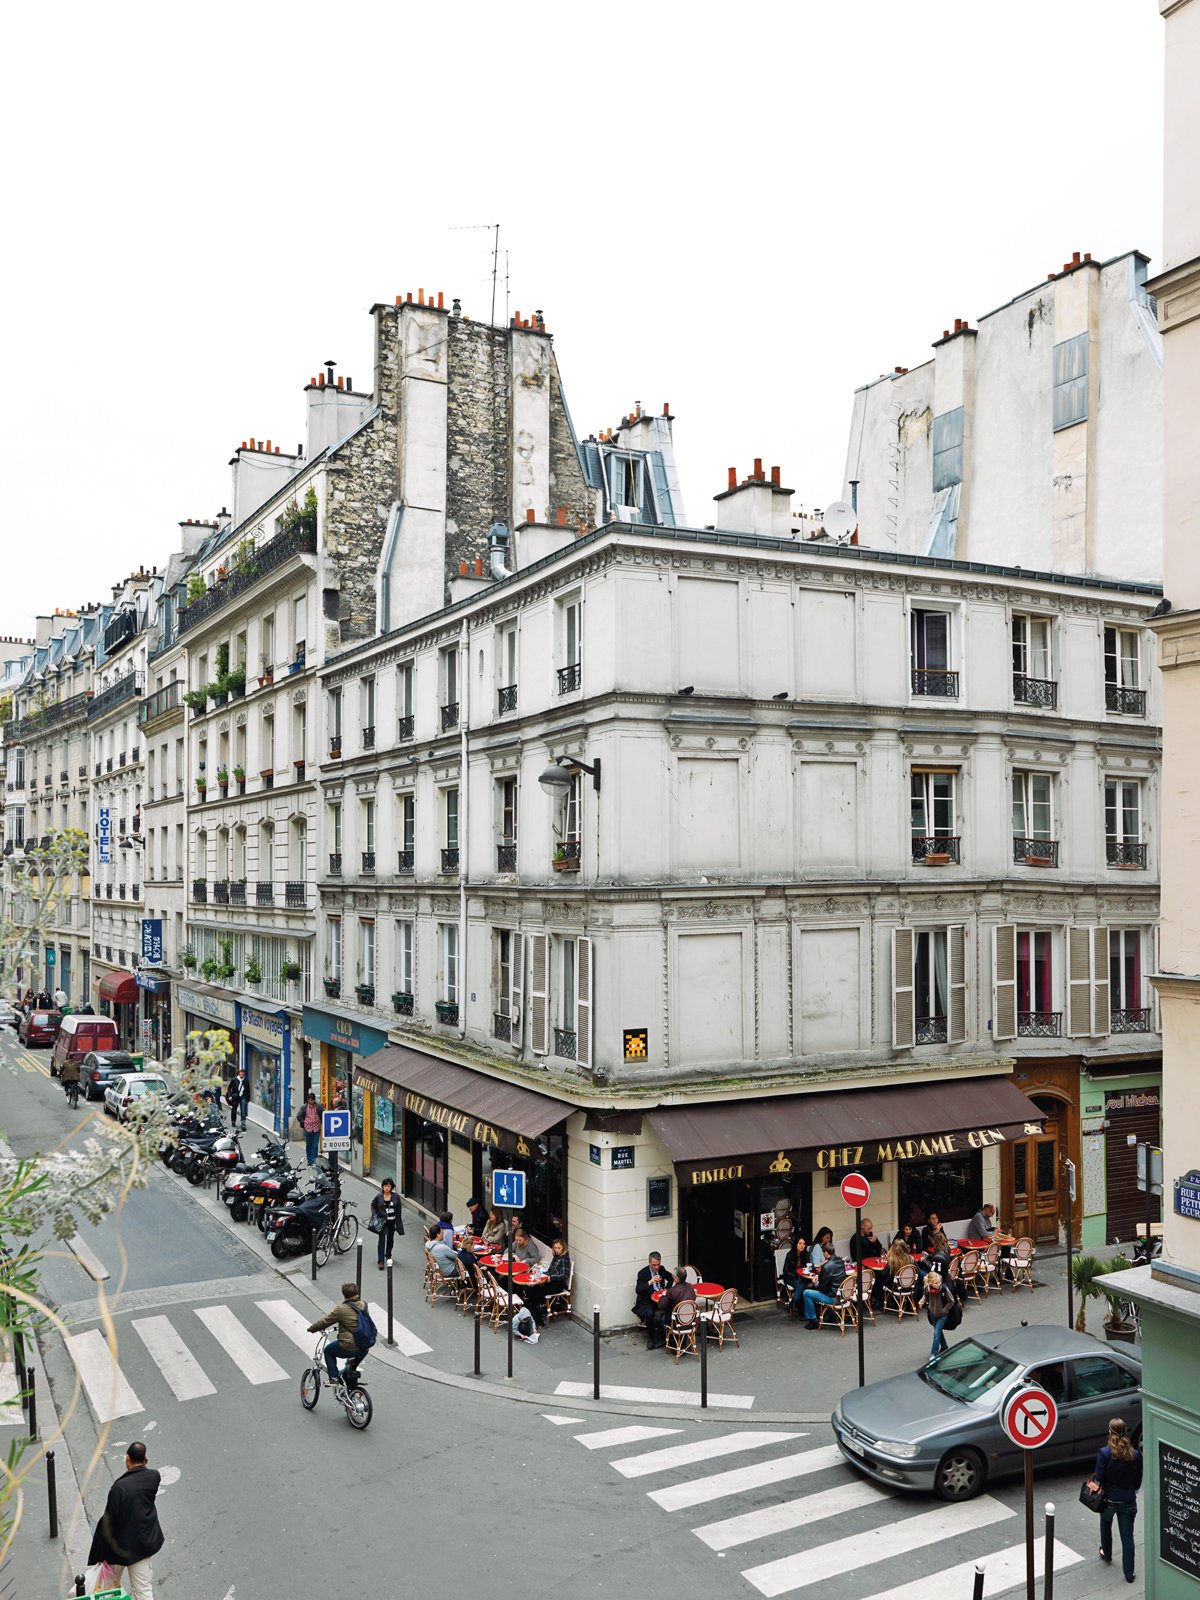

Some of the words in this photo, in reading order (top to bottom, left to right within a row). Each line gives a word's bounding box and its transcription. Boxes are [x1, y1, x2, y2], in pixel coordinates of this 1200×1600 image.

[100, 808, 109, 854] HOTEL
[330, 1116, 343, 1134] P
[405, 1092, 425, 1115] CHEZ
[428, 1104, 470, 1134] MADAME
[474, 1122, 499, 1147] GEN
[816, 1146, 864, 1169] CHEZ
[876, 1134, 959, 1162] MADAME
[967, 1128, 1006, 1149] GEN
[692, 1165, 744, 1185] BISTROT
[1180, 1187, 1195, 1199] RUE
